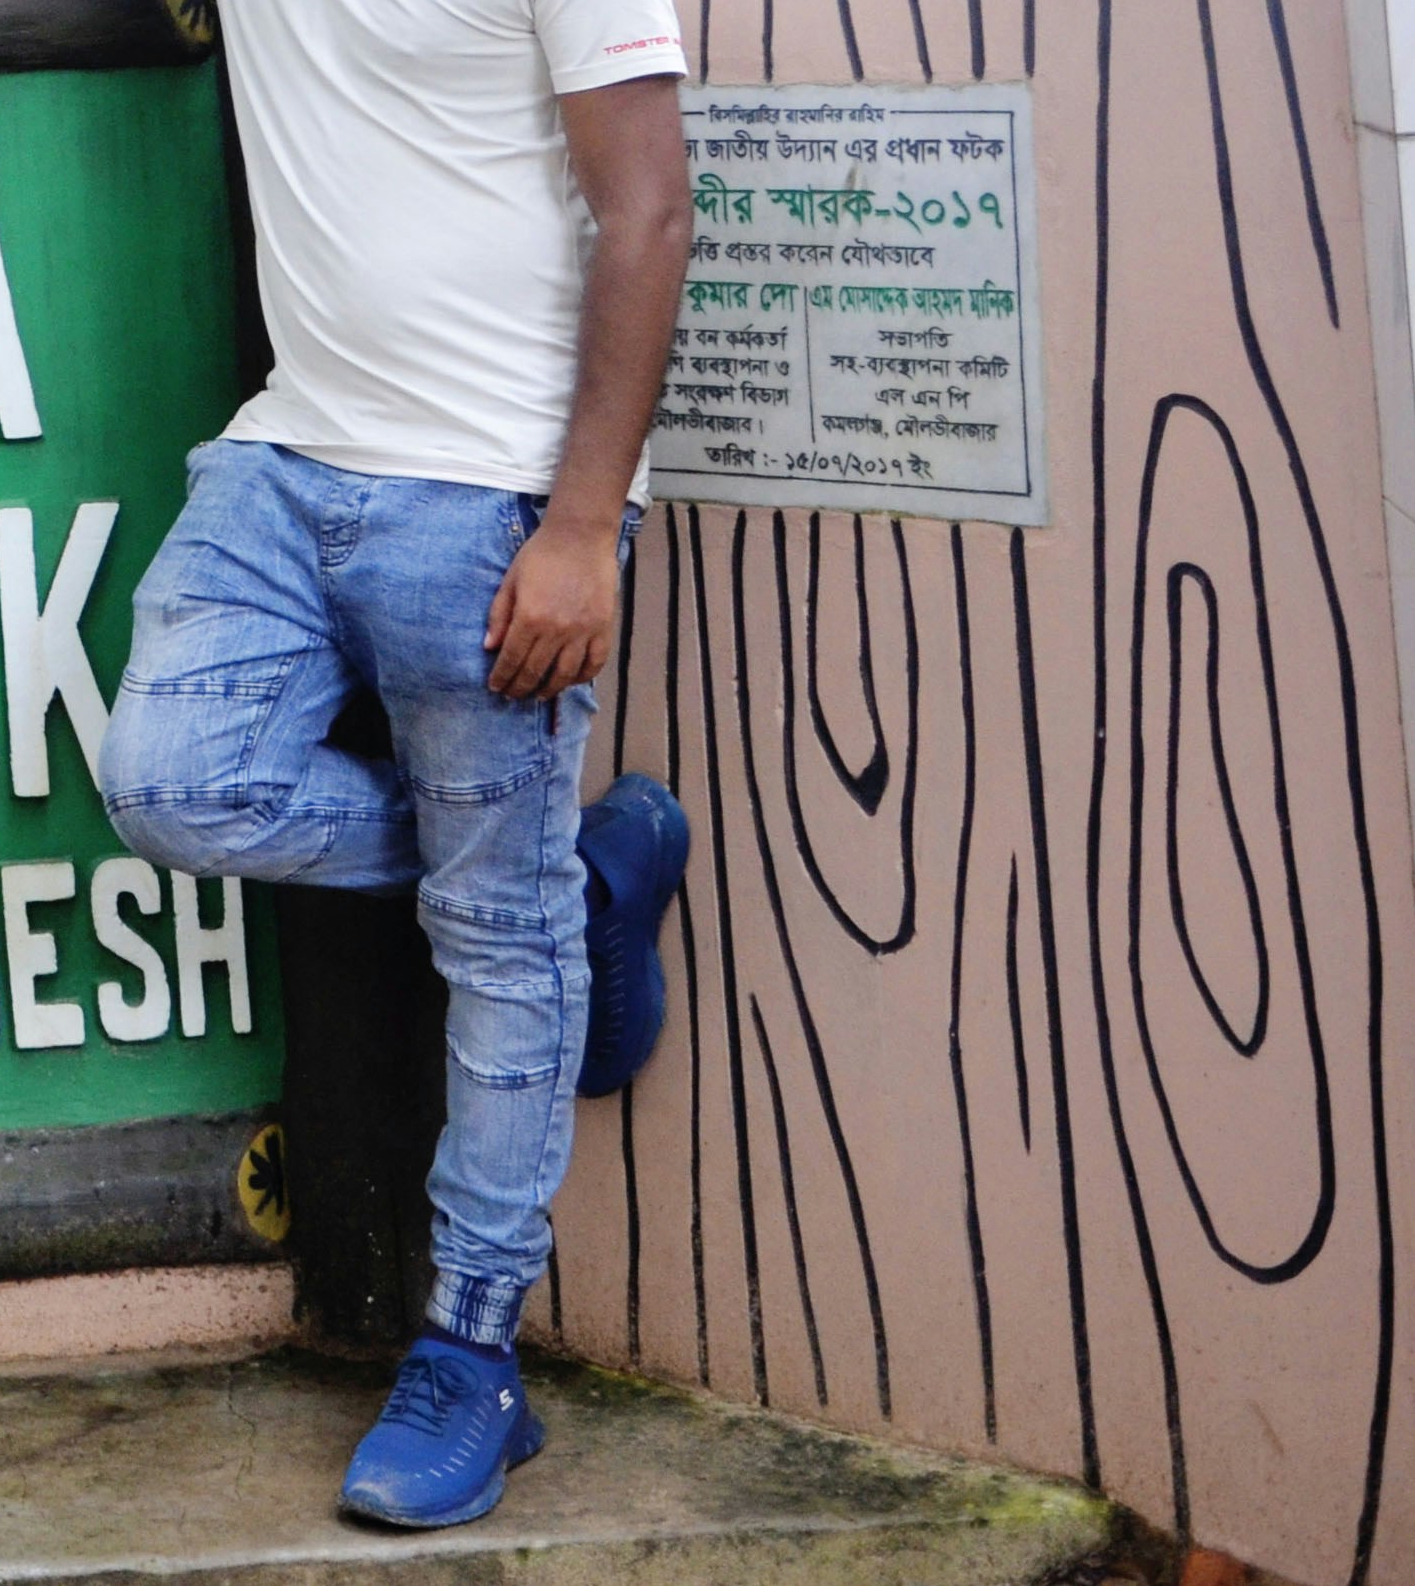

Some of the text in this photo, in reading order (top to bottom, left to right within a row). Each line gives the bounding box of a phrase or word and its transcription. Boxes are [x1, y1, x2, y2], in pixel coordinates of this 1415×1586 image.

[705, 130, 770, 161] জাতীয়
[775, 131, 838, 162] উদ্যান
[845, 138, 878, 162] এর
[885, 137, 941, 164] প্রধান
[947, 130, 1004, 162] ফটক
[776, 243, 834, 264] করেন
[841, 238, 936, 268] যৌথভাবে
[685, 280, 754, 315] কুমার
[694, 329, 720, 346] বন
[878, 326, 953, 348] সভাপতি
[956, 355, 1011, 378] কমিটি
[875, 386, 971, 409] এল এন পি
